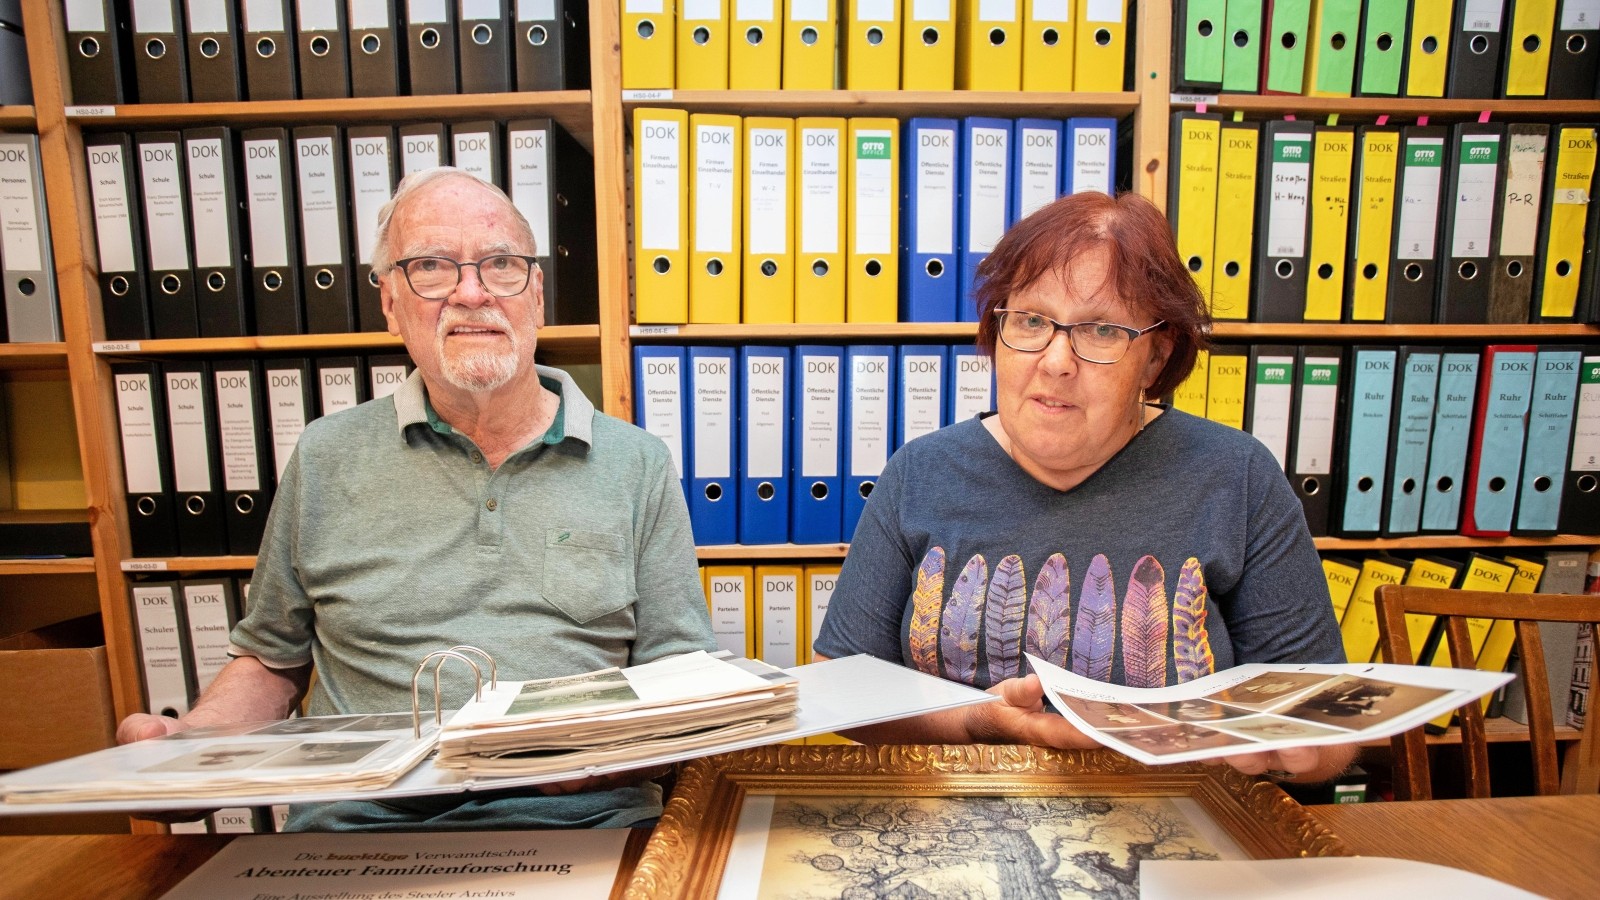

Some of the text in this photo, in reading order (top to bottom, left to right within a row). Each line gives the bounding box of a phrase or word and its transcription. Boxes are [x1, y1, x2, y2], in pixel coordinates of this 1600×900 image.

[645, 126, 675, 140] DOK
[701, 132, 730, 145] DOK
[1188, 131, 1213, 141] DOK
[458, 138, 487, 152] DOK
[514, 136, 543, 149] DOK
[754, 135, 784, 147] DOK
[806, 134, 835, 147] DOK
[862, 142, 884, 150] OTTO
[922, 135, 949, 148] DOK
[976, 134, 1003, 147] DOK
[1026, 135, 1054, 148] DOK
[1078, 134, 1106, 146] DOK
[1229, 140, 1252, 150] DOK
[1568, 140, 1593, 149] DOK
[191, 145, 219, 158] DOK
[249, 146, 276, 159] DOK
[301, 144, 329, 157] DOK
[355, 144, 384, 156] DOK
[407, 141, 435, 154] DOK
[1282, 146, 1302, 154] OTTO
[1324, 142, 1348, 152] DOK
[1369, 144, 1394, 152] DOK
[92, 152, 120, 164] DOK
[144, 149, 174, 162] DOK
[1414, 150, 1435, 158] OTTO
[974, 160, 1002, 168] Öffentliche
[1186, 164, 1213, 172] Straßen
[1226, 172, 1252, 180] Straßen
[1365, 176, 1392, 184] Straßen
[1562, 172, 1590, 180] Straßen
[648, 362, 676, 375] DOK
[698, 362, 726, 374] DOK
[752, 362, 780, 375] DOK
[808, 362, 836, 374] DOK
[856, 362, 885, 374] DOK
[909, 361, 937, 373] DOK
[961, 360, 989, 372] DOK
[1218, 366, 1242, 376] DOK
[1365, 361, 1390, 370] DOK
[1412, 364, 1434, 373] DOK
[1448, 364, 1473, 372] DOK
[1501, 362, 1530, 372] DOK
[1546, 362, 1574, 370] DOK
[376, 372, 403, 384] DOK
[1264, 368, 1285, 376] OTTO
[1312, 369, 1332, 377] OTTO
[120, 380, 148, 392] DOK
[170, 378, 198, 390] DOK
[220, 377, 247, 388] DOK
[272, 376, 298, 388] DOK
[324, 374, 352, 386] DOK
[1364, 392, 1384, 400] Ruhr
[1446, 394, 1467, 402] Ruhr
[1328, 572, 1353, 586] DOK
[1371, 570, 1399, 585] DOK
[1422, 570, 1449, 584] DOK
[1474, 568, 1502, 583] DOK
[714, 582, 742, 593] DOK
[766, 581, 794, 592] DOK
[142, 596, 168, 606] DOK
[194, 594, 220, 604] DOK
[222, 816, 246, 825] DOK
[294, 848, 538, 862] Die bucklige Verwandtschaft
[234, 862, 574, 878] Abenteuer Familienforschung
[292, 892, 374, 900] Ausstellung
[406, 890, 456, 899] Steeler
[459, 889, 516, 898] Archivs
